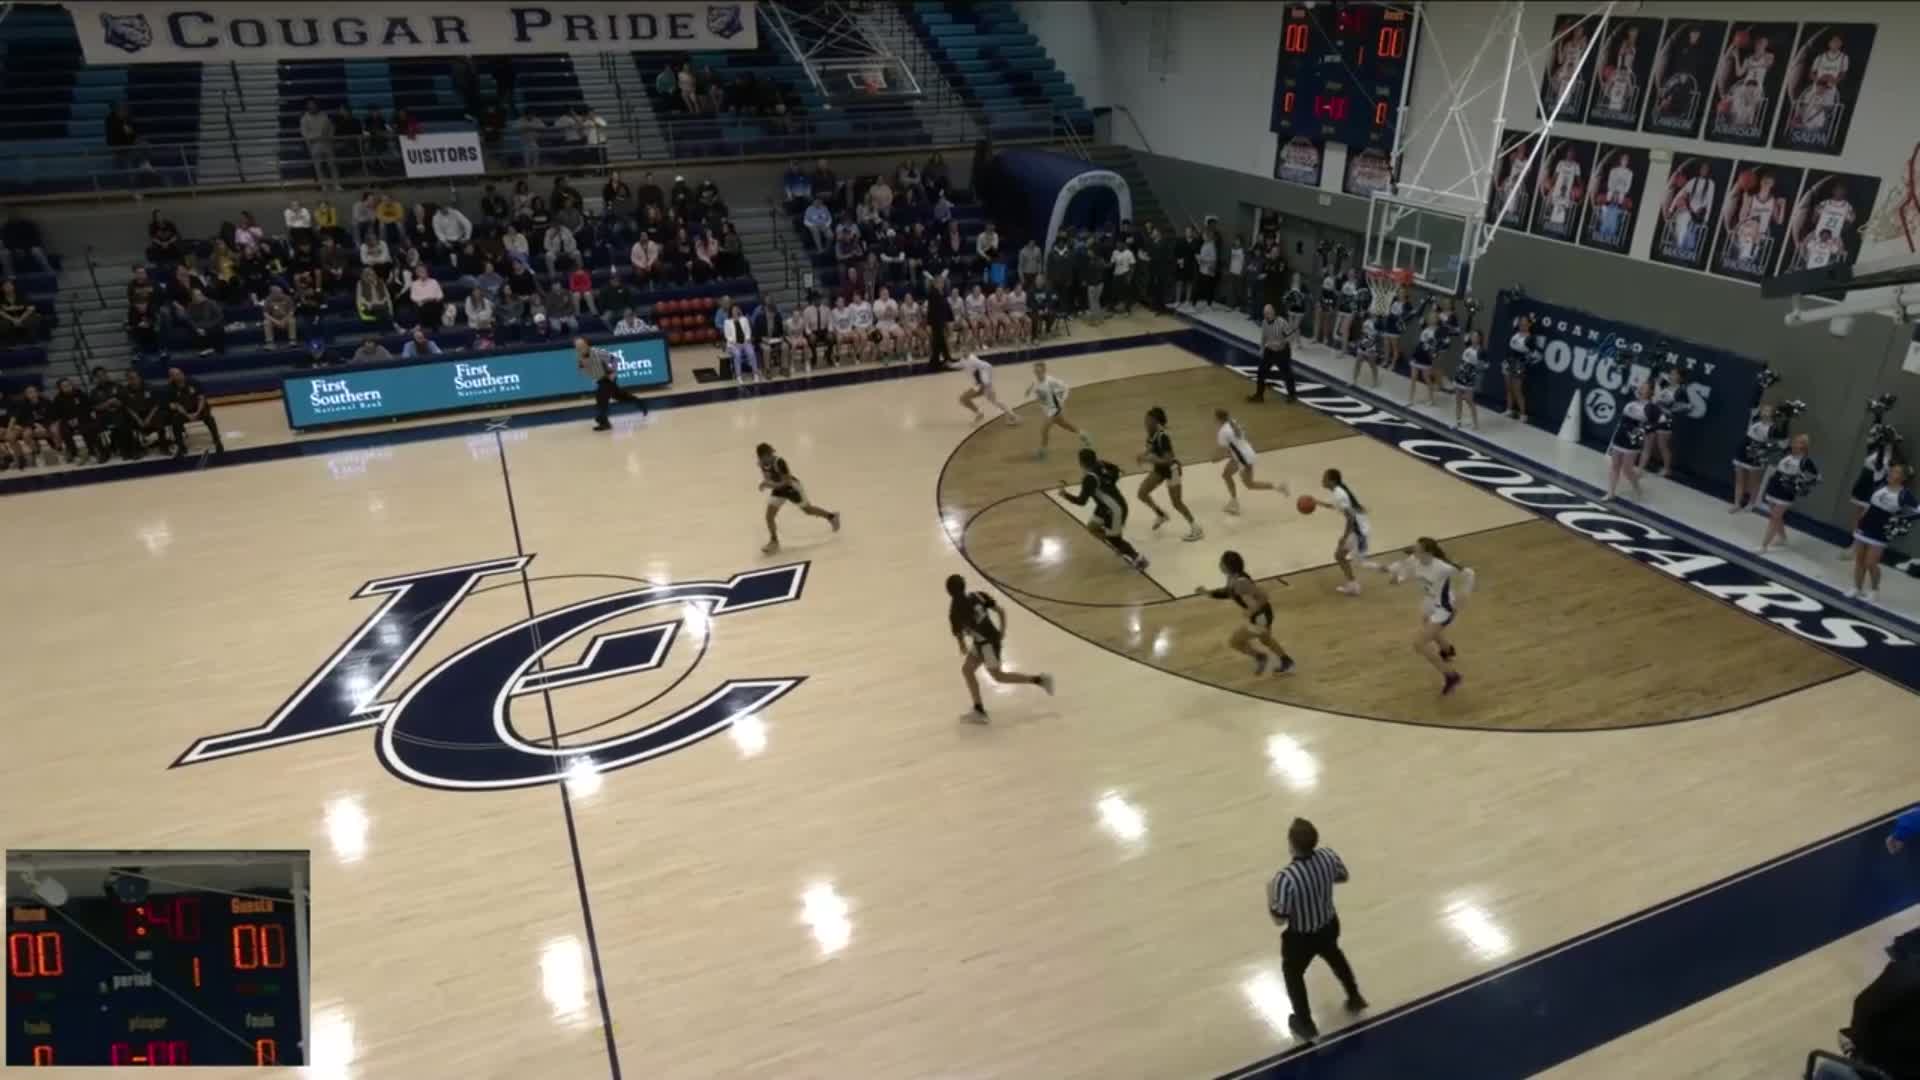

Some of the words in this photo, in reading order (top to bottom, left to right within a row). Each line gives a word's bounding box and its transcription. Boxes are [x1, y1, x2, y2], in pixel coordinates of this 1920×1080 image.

[166, 10, 471, 49] COUGAR
[512, 6, 696, 43] PRIDE
[407, 146, 478, 165] VISITORS
[1615, 336, 1716, 375] CONTY
[456, 363, 488, 378] First
[311, 379, 347, 394] First
[454, 374, 521, 390] Southern
[310, 390, 382, 407] Southern
[1398, 438, 1917, 649] COUGARS
